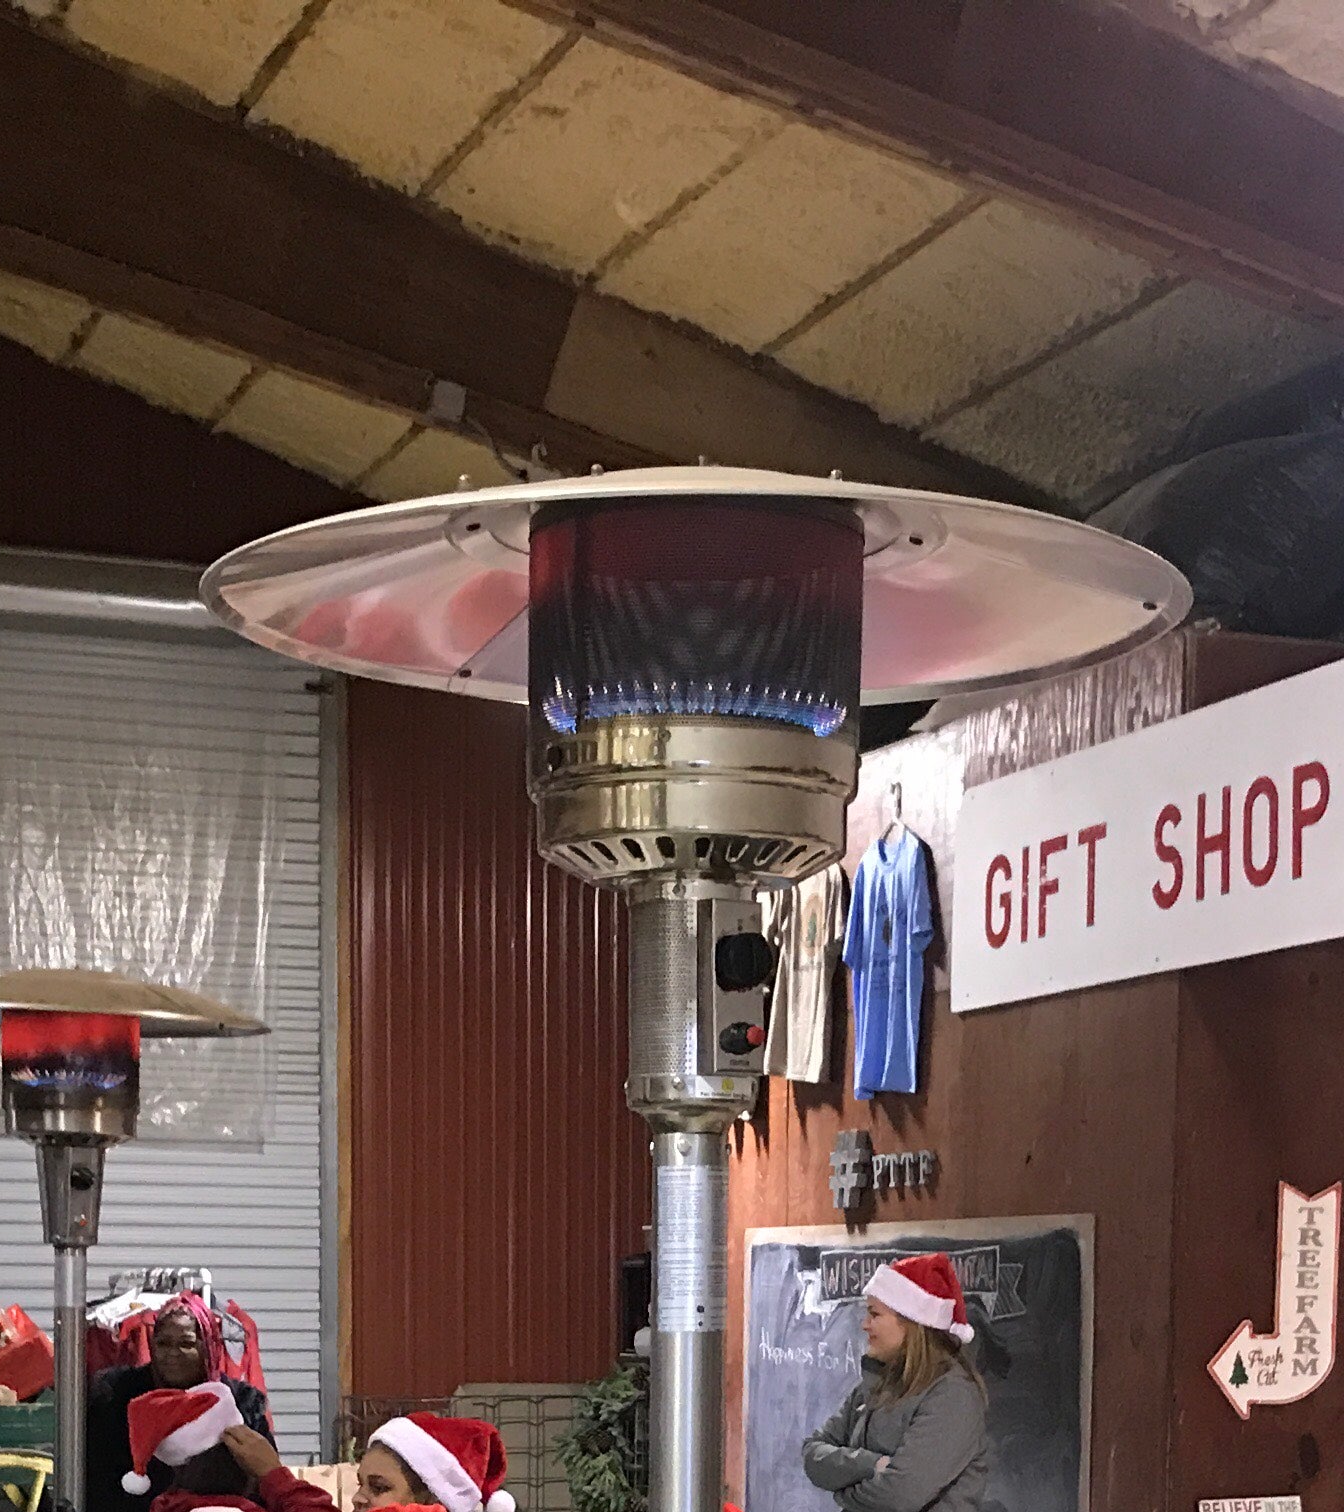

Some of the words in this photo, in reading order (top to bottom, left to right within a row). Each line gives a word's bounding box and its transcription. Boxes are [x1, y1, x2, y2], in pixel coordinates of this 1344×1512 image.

[985, 821, 1107, 949] GIFT
[1152, 761, 1330, 910] SHOP
[829, 1129, 934, 1208] #PTTF
[1295, 1206, 1324, 1290] TREE
[1248, 1347, 1284, 1371] Fresh
[1291, 1295, 1321, 1377] FARM
[1257, 1369, 1279, 1386] Cut
